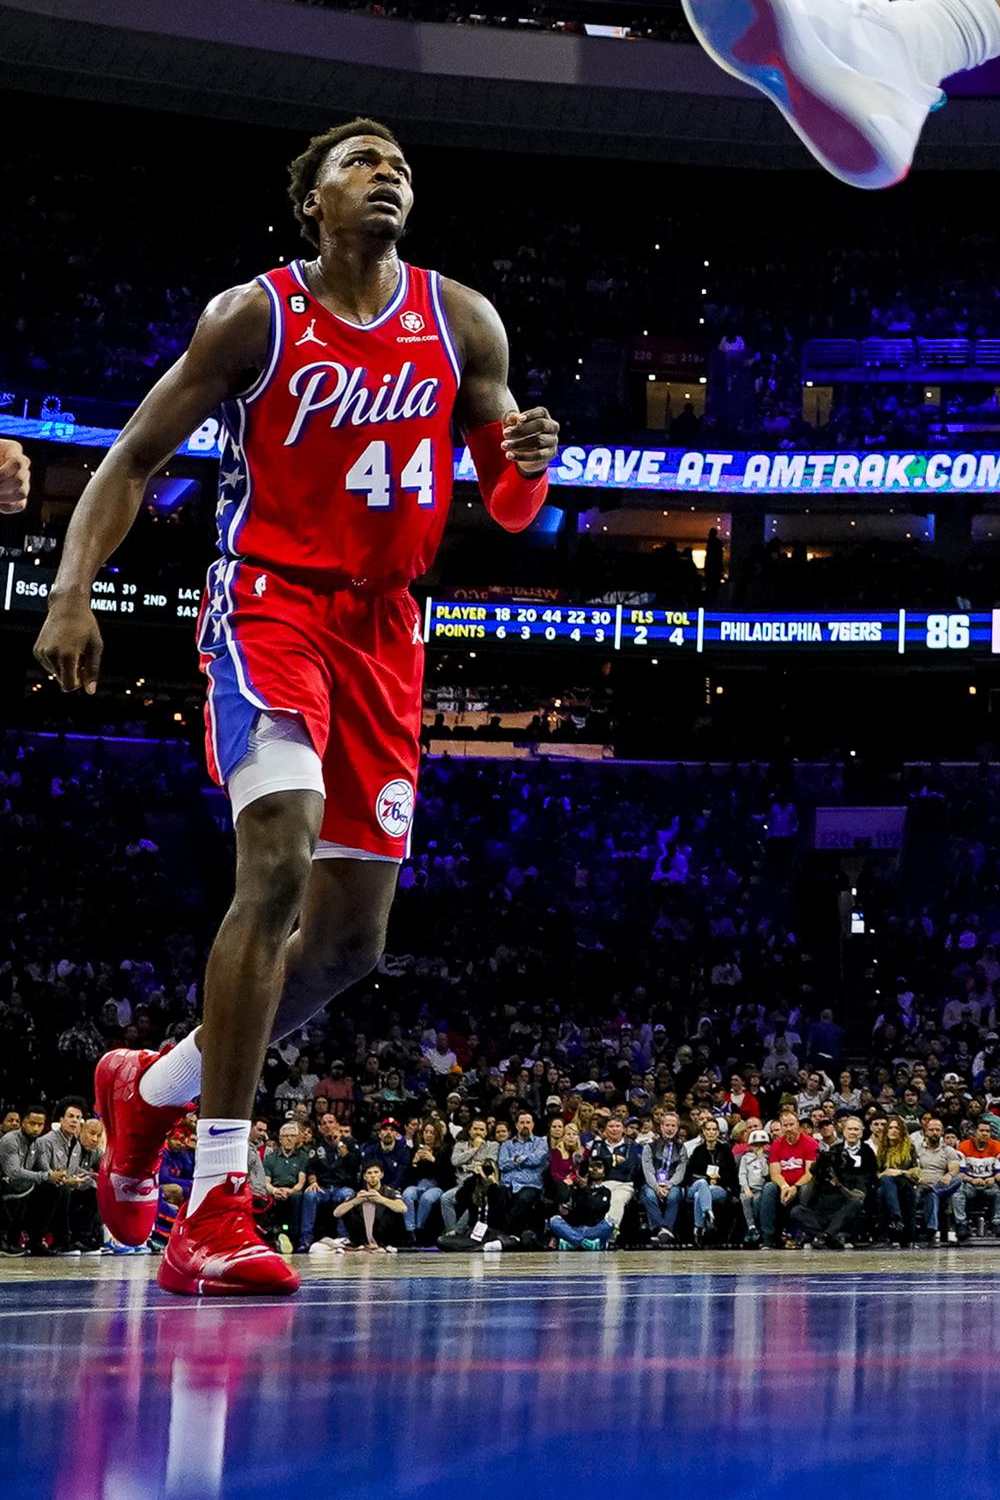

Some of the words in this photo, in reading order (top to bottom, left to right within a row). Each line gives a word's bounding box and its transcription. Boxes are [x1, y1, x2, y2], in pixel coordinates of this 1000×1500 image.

[290, 295, 306, 313] 6
[396, 334, 439, 344] crypto.com
[284, 360, 440, 446] Phila
[345, 438, 434, 508] 44
[556, 446, 662, 484] SAVE
[677, 452, 733, 486] AT
[15, 580, 48, 597] 8:56
[92, 581, 115, 594] CHA
[143, 594, 167, 607] 2ND
[178, 588, 200, 600] LAC
[90, 599, 117, 611] MEM
[120, 601, 134, 613] 53
[177, 605, 198, 618] SAS
[436, 606, 486, 620] PLAYER
[494, 607, 510, 621] 18
[517, 608, 537, 622] 20
[542, 609, 561, 622] 44
[567, 610, 585, 624] 22
[591, 611, 611, 625] 30
[631, 610, 654, 624] FLS
[665, 611, 690, 625] TOL
[435, 623, 485, 638] POINTS
[496, 625, 506, 639] 6
[520, 626, 530, 640] 3
[545, 627, 556, 640] 0
[570, 628, 580, 642] 4
[595, 628, 605, 642] 3
[633, 627, 648, 645] 2
[668, 628, 685, 646] 4
[720, 621, 822, 641] PHILADELPHIA
[828, 622, 882, 641] 76ERS
[926, 614, 970, 649] 86
